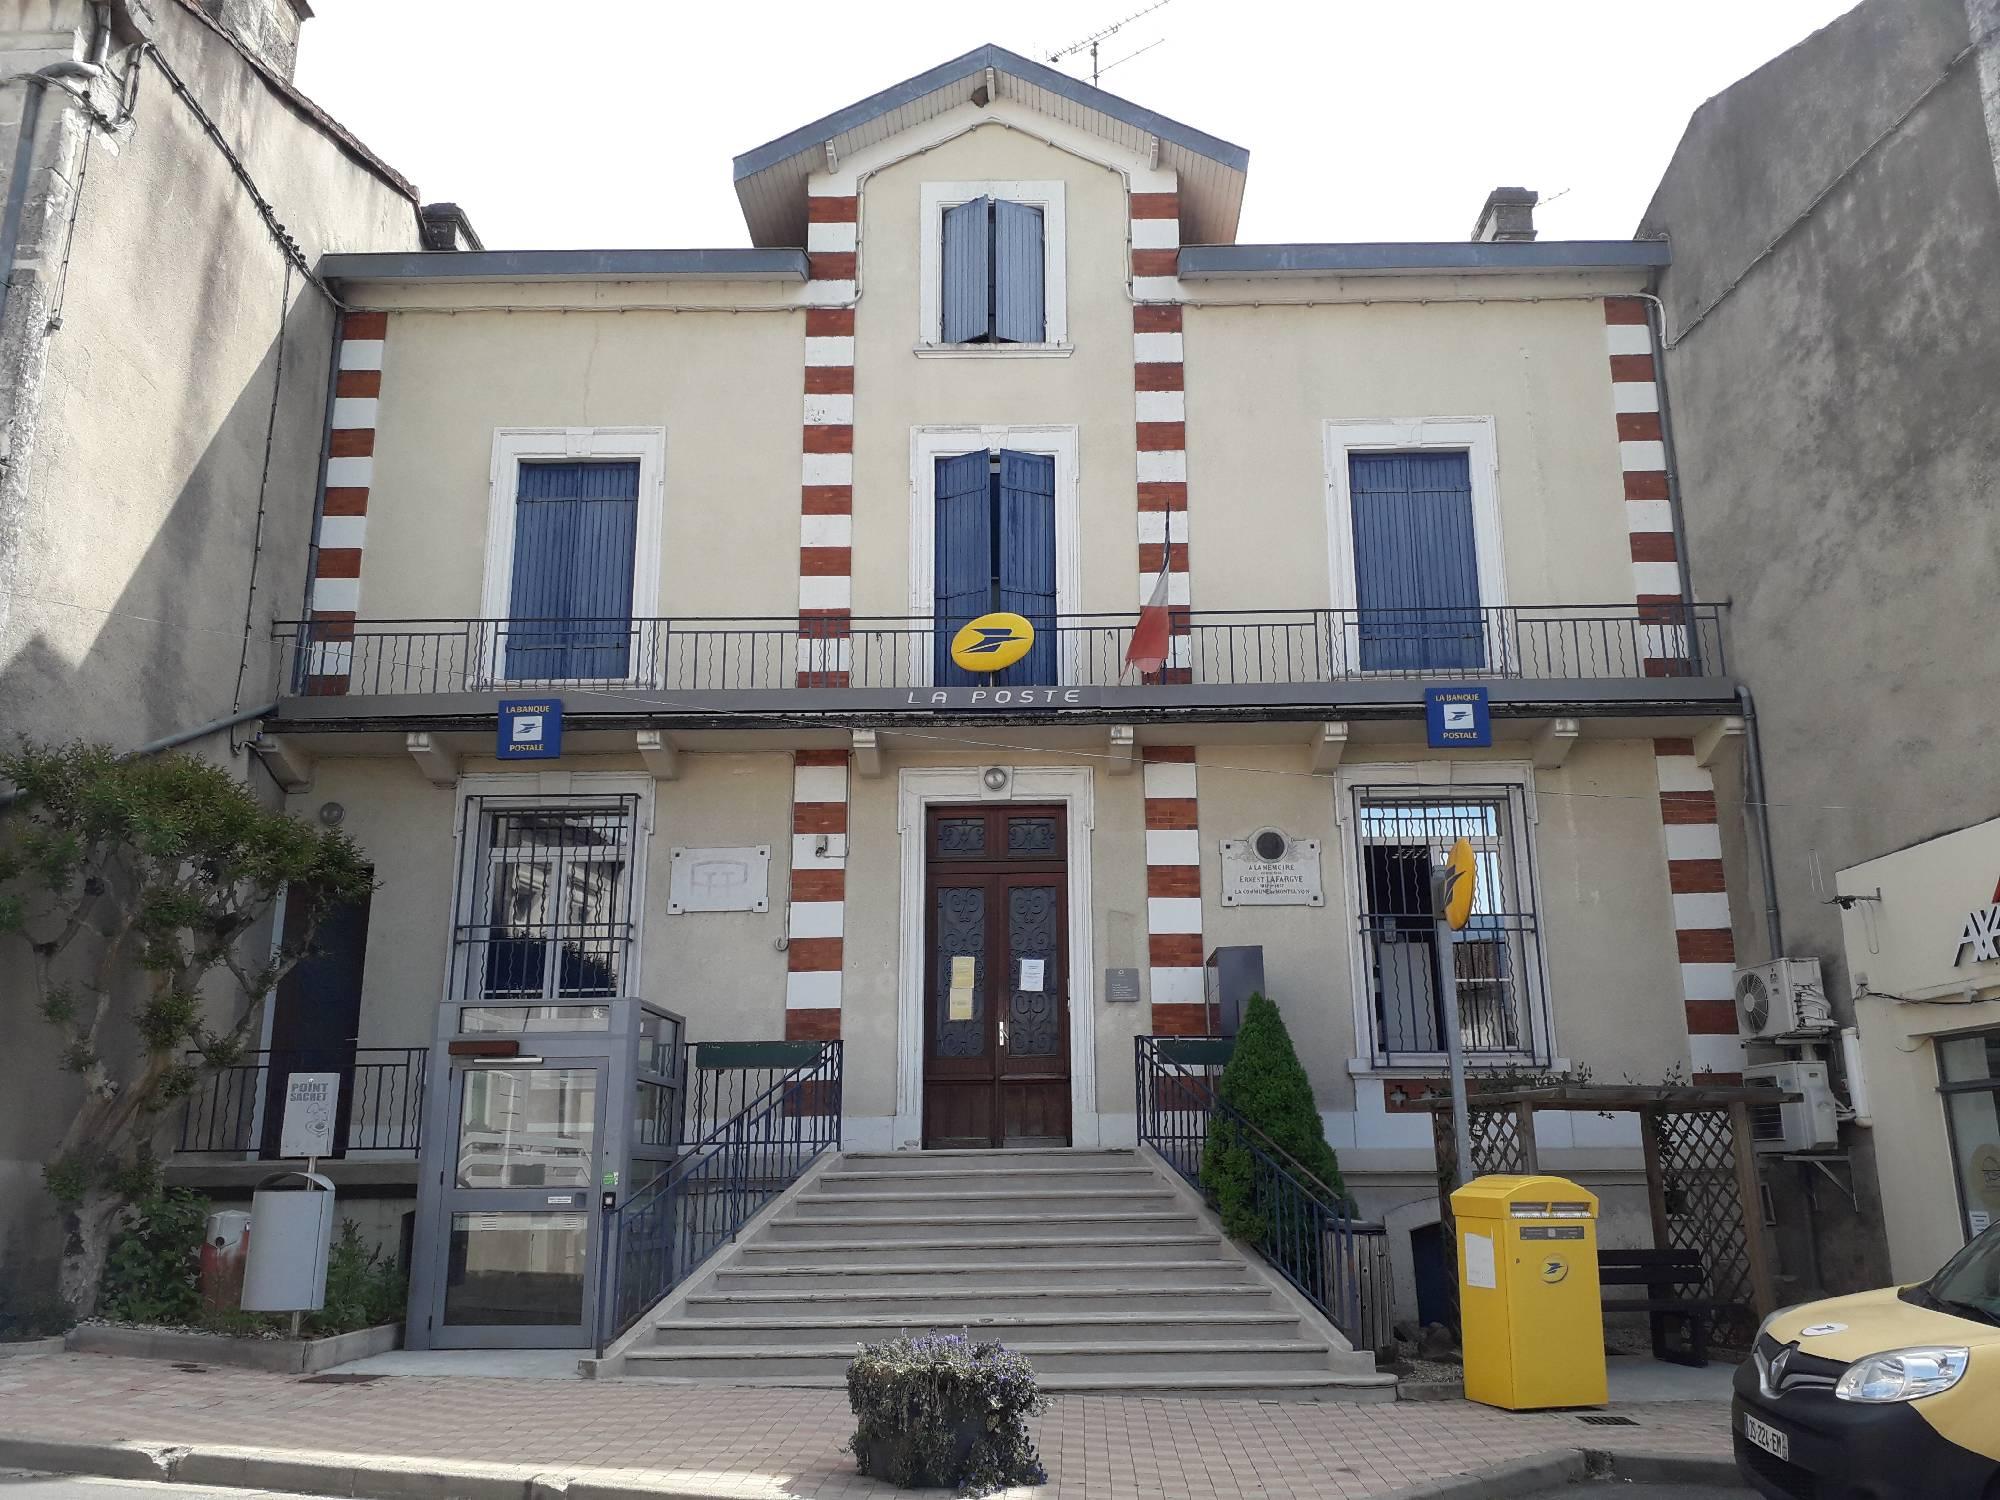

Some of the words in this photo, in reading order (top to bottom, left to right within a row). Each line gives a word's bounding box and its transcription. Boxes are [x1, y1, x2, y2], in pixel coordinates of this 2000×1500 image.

[907, 691, 948, 704] LA
[971, 690, 1081, 704] POSTE
[1446, 694, 1480, 702] BANQUE
[506, 706, 516, 714] LA
[516, 705, 550, 713] BANQUE
[509, 744, 544, 752] POSTALE
[291, 1082, 329, 1092] POINT
[290, 1093, 328, 1101] SACHET
